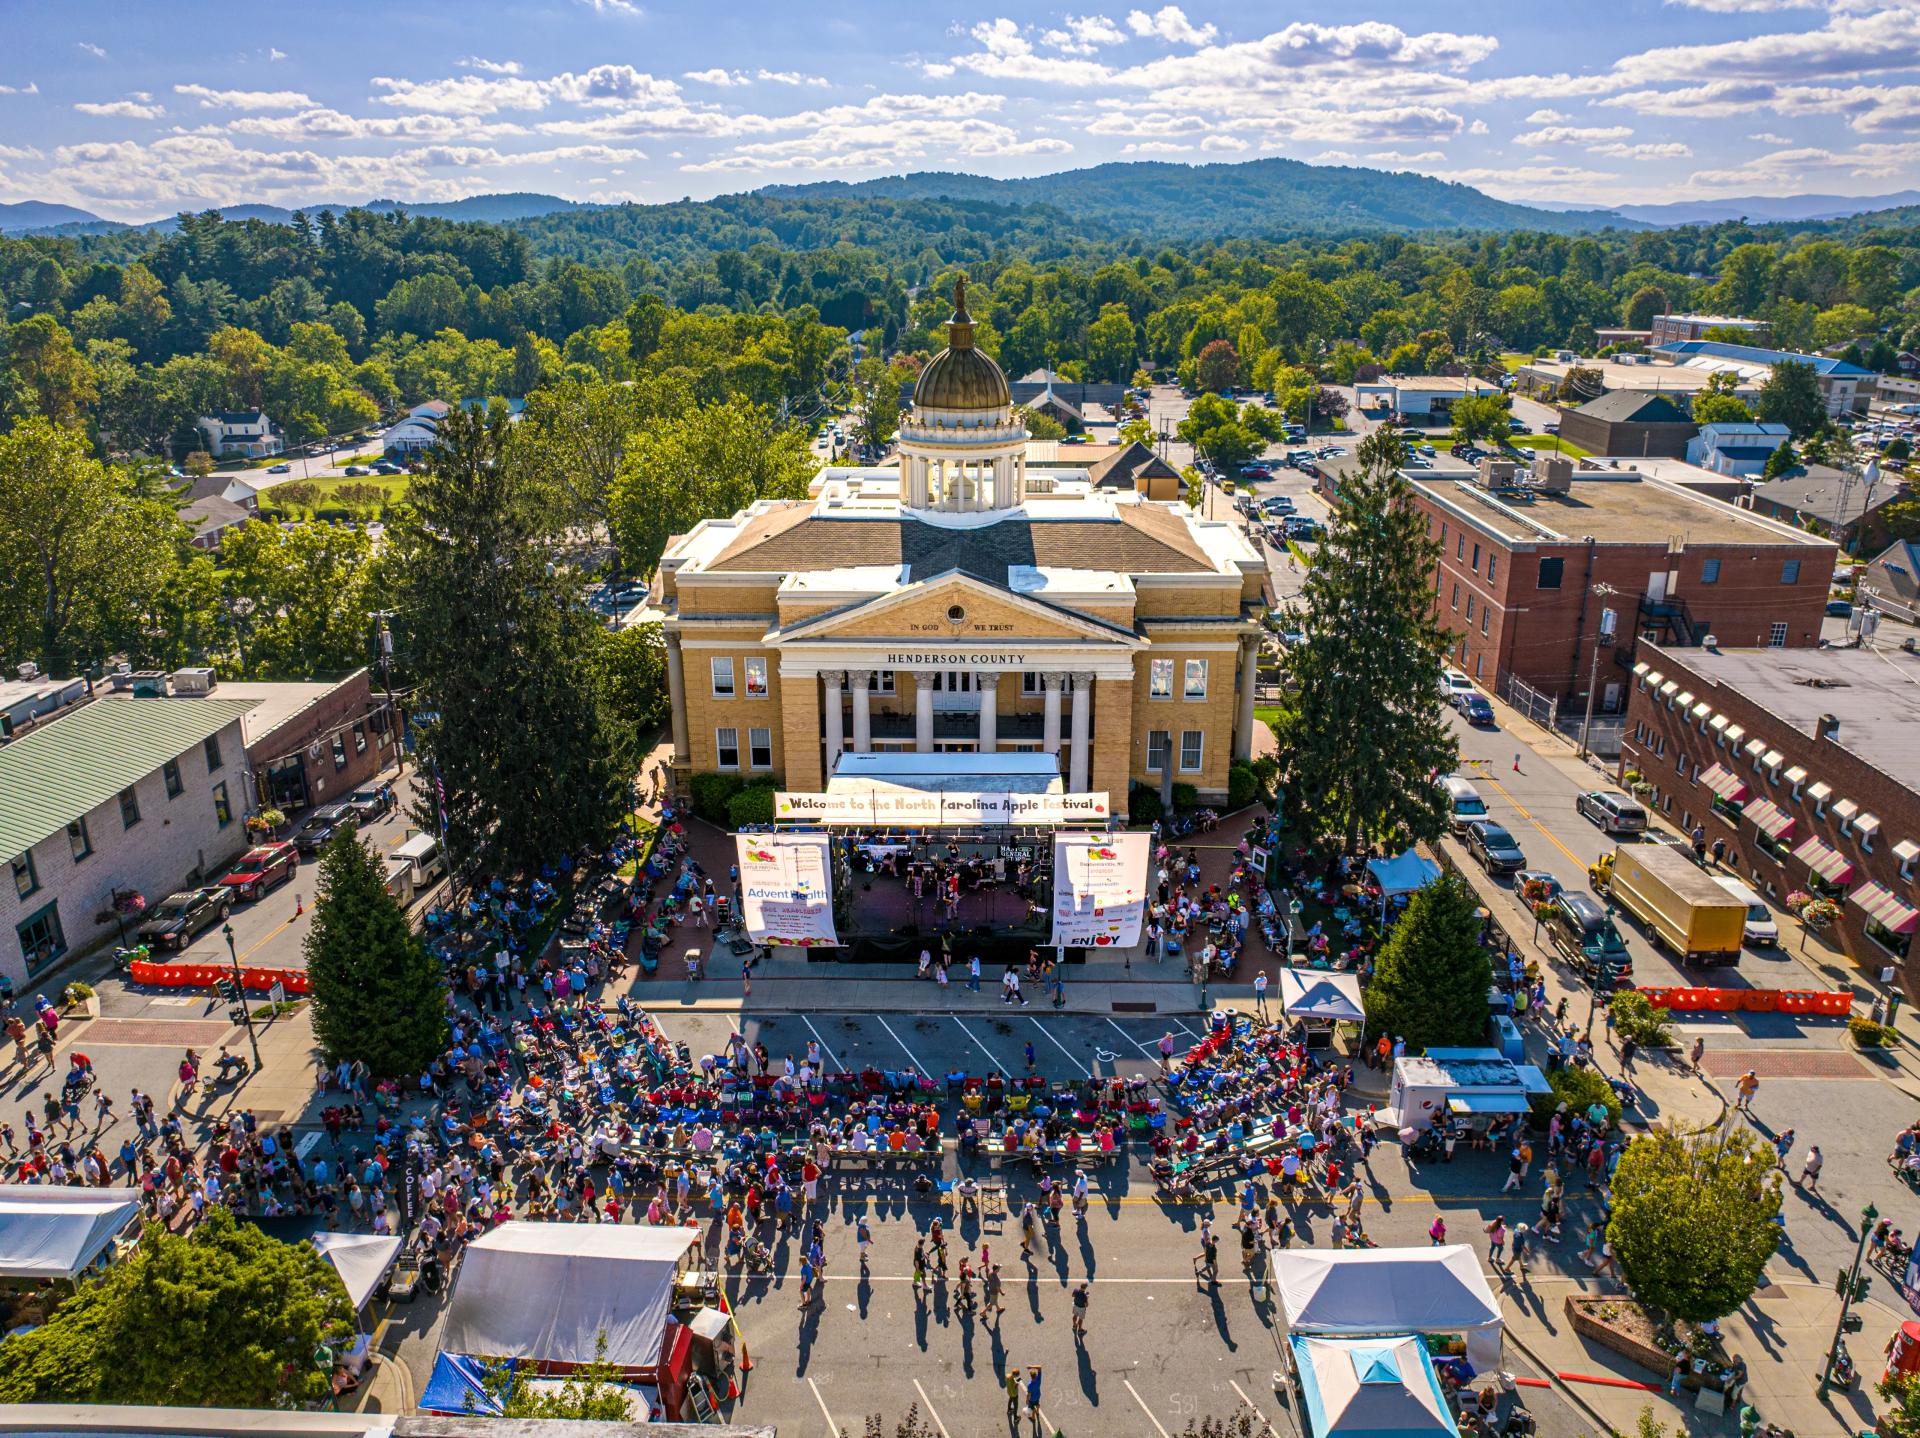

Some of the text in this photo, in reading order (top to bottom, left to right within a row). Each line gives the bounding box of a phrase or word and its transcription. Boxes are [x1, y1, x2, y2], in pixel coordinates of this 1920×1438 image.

[887, 654, 1026, 664] HENDERSON COUNTY
[789, 798, 1093, 814] Welcome to the North Carolina Apple Festival
[748, 888, 828, 900] AdventHealth
[405, 1168, 415, 1218] COFFEE
[1168, 1392, 1198, 1414] 185
